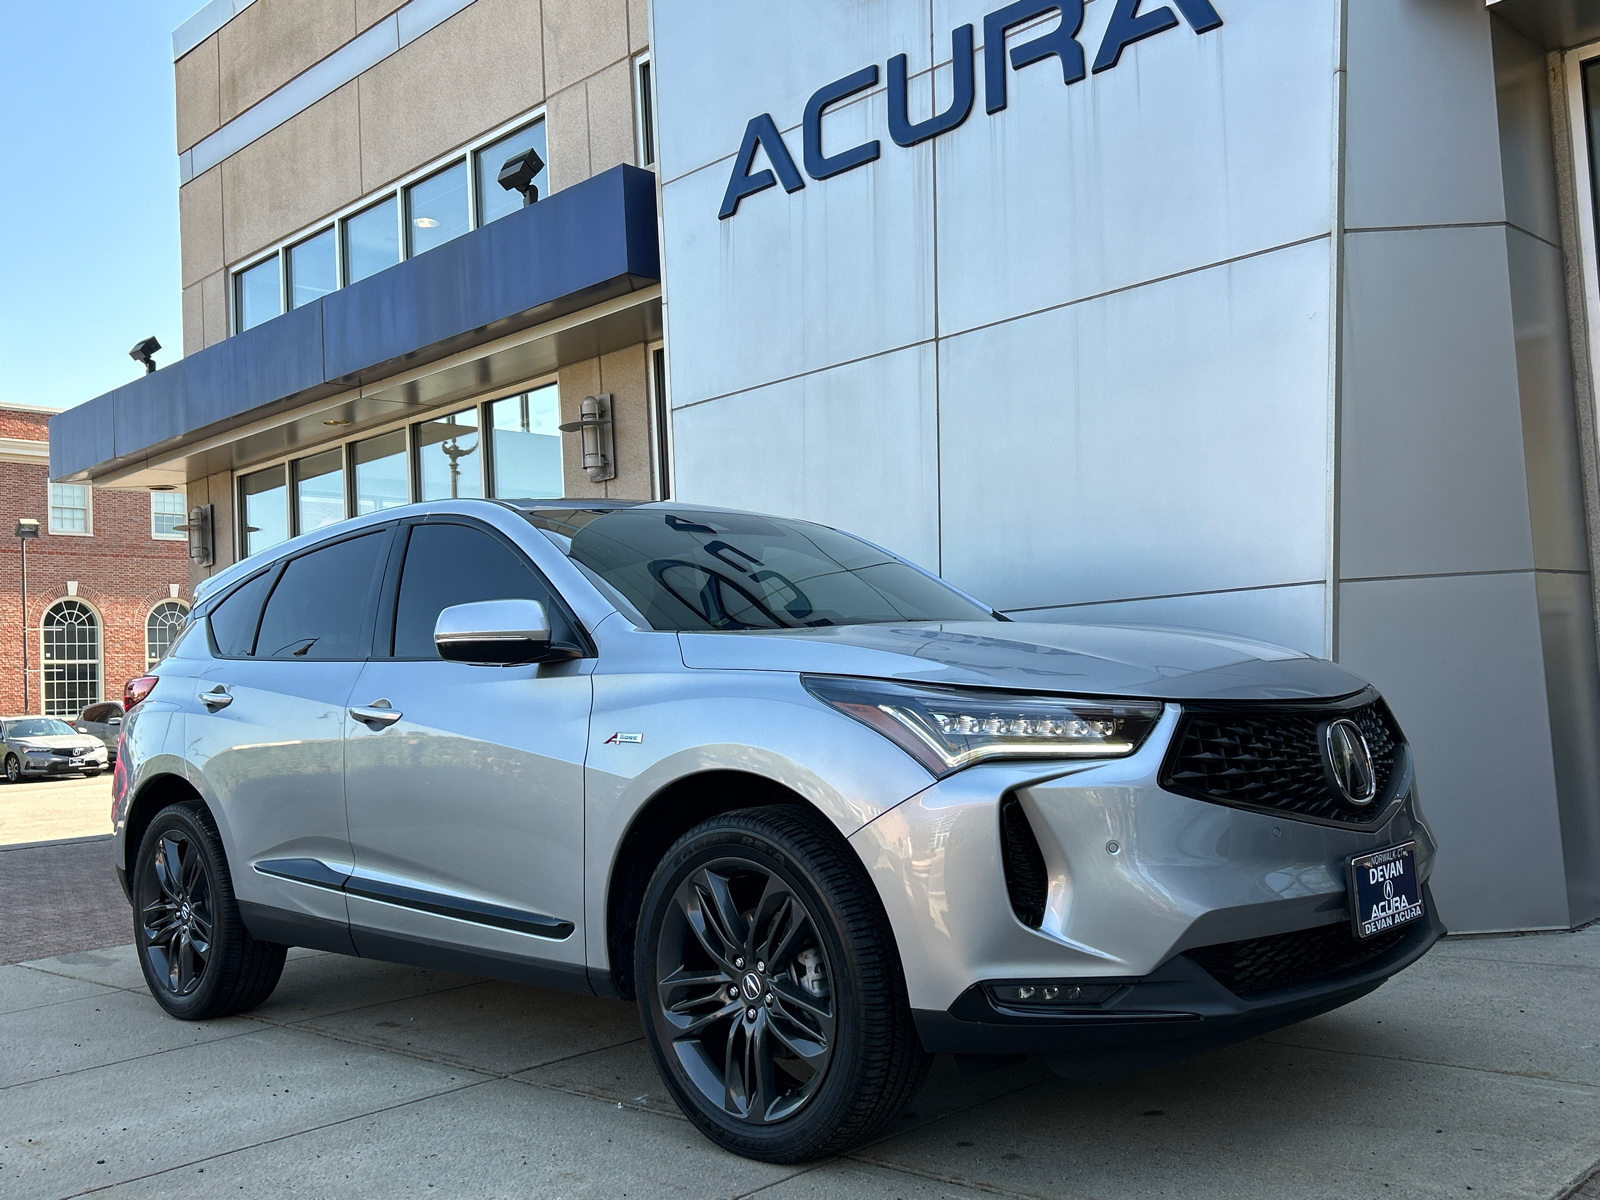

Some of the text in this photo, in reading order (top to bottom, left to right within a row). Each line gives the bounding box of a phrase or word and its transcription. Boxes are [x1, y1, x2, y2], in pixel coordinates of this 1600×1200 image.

[718, 0, 1223, 220] ACURA
[1369, 860, 1404, 885] DEVAN
[1365, 906, 1422, 935] DEVAN ACURA
[1371, 894, 1409, 920] ACURA
